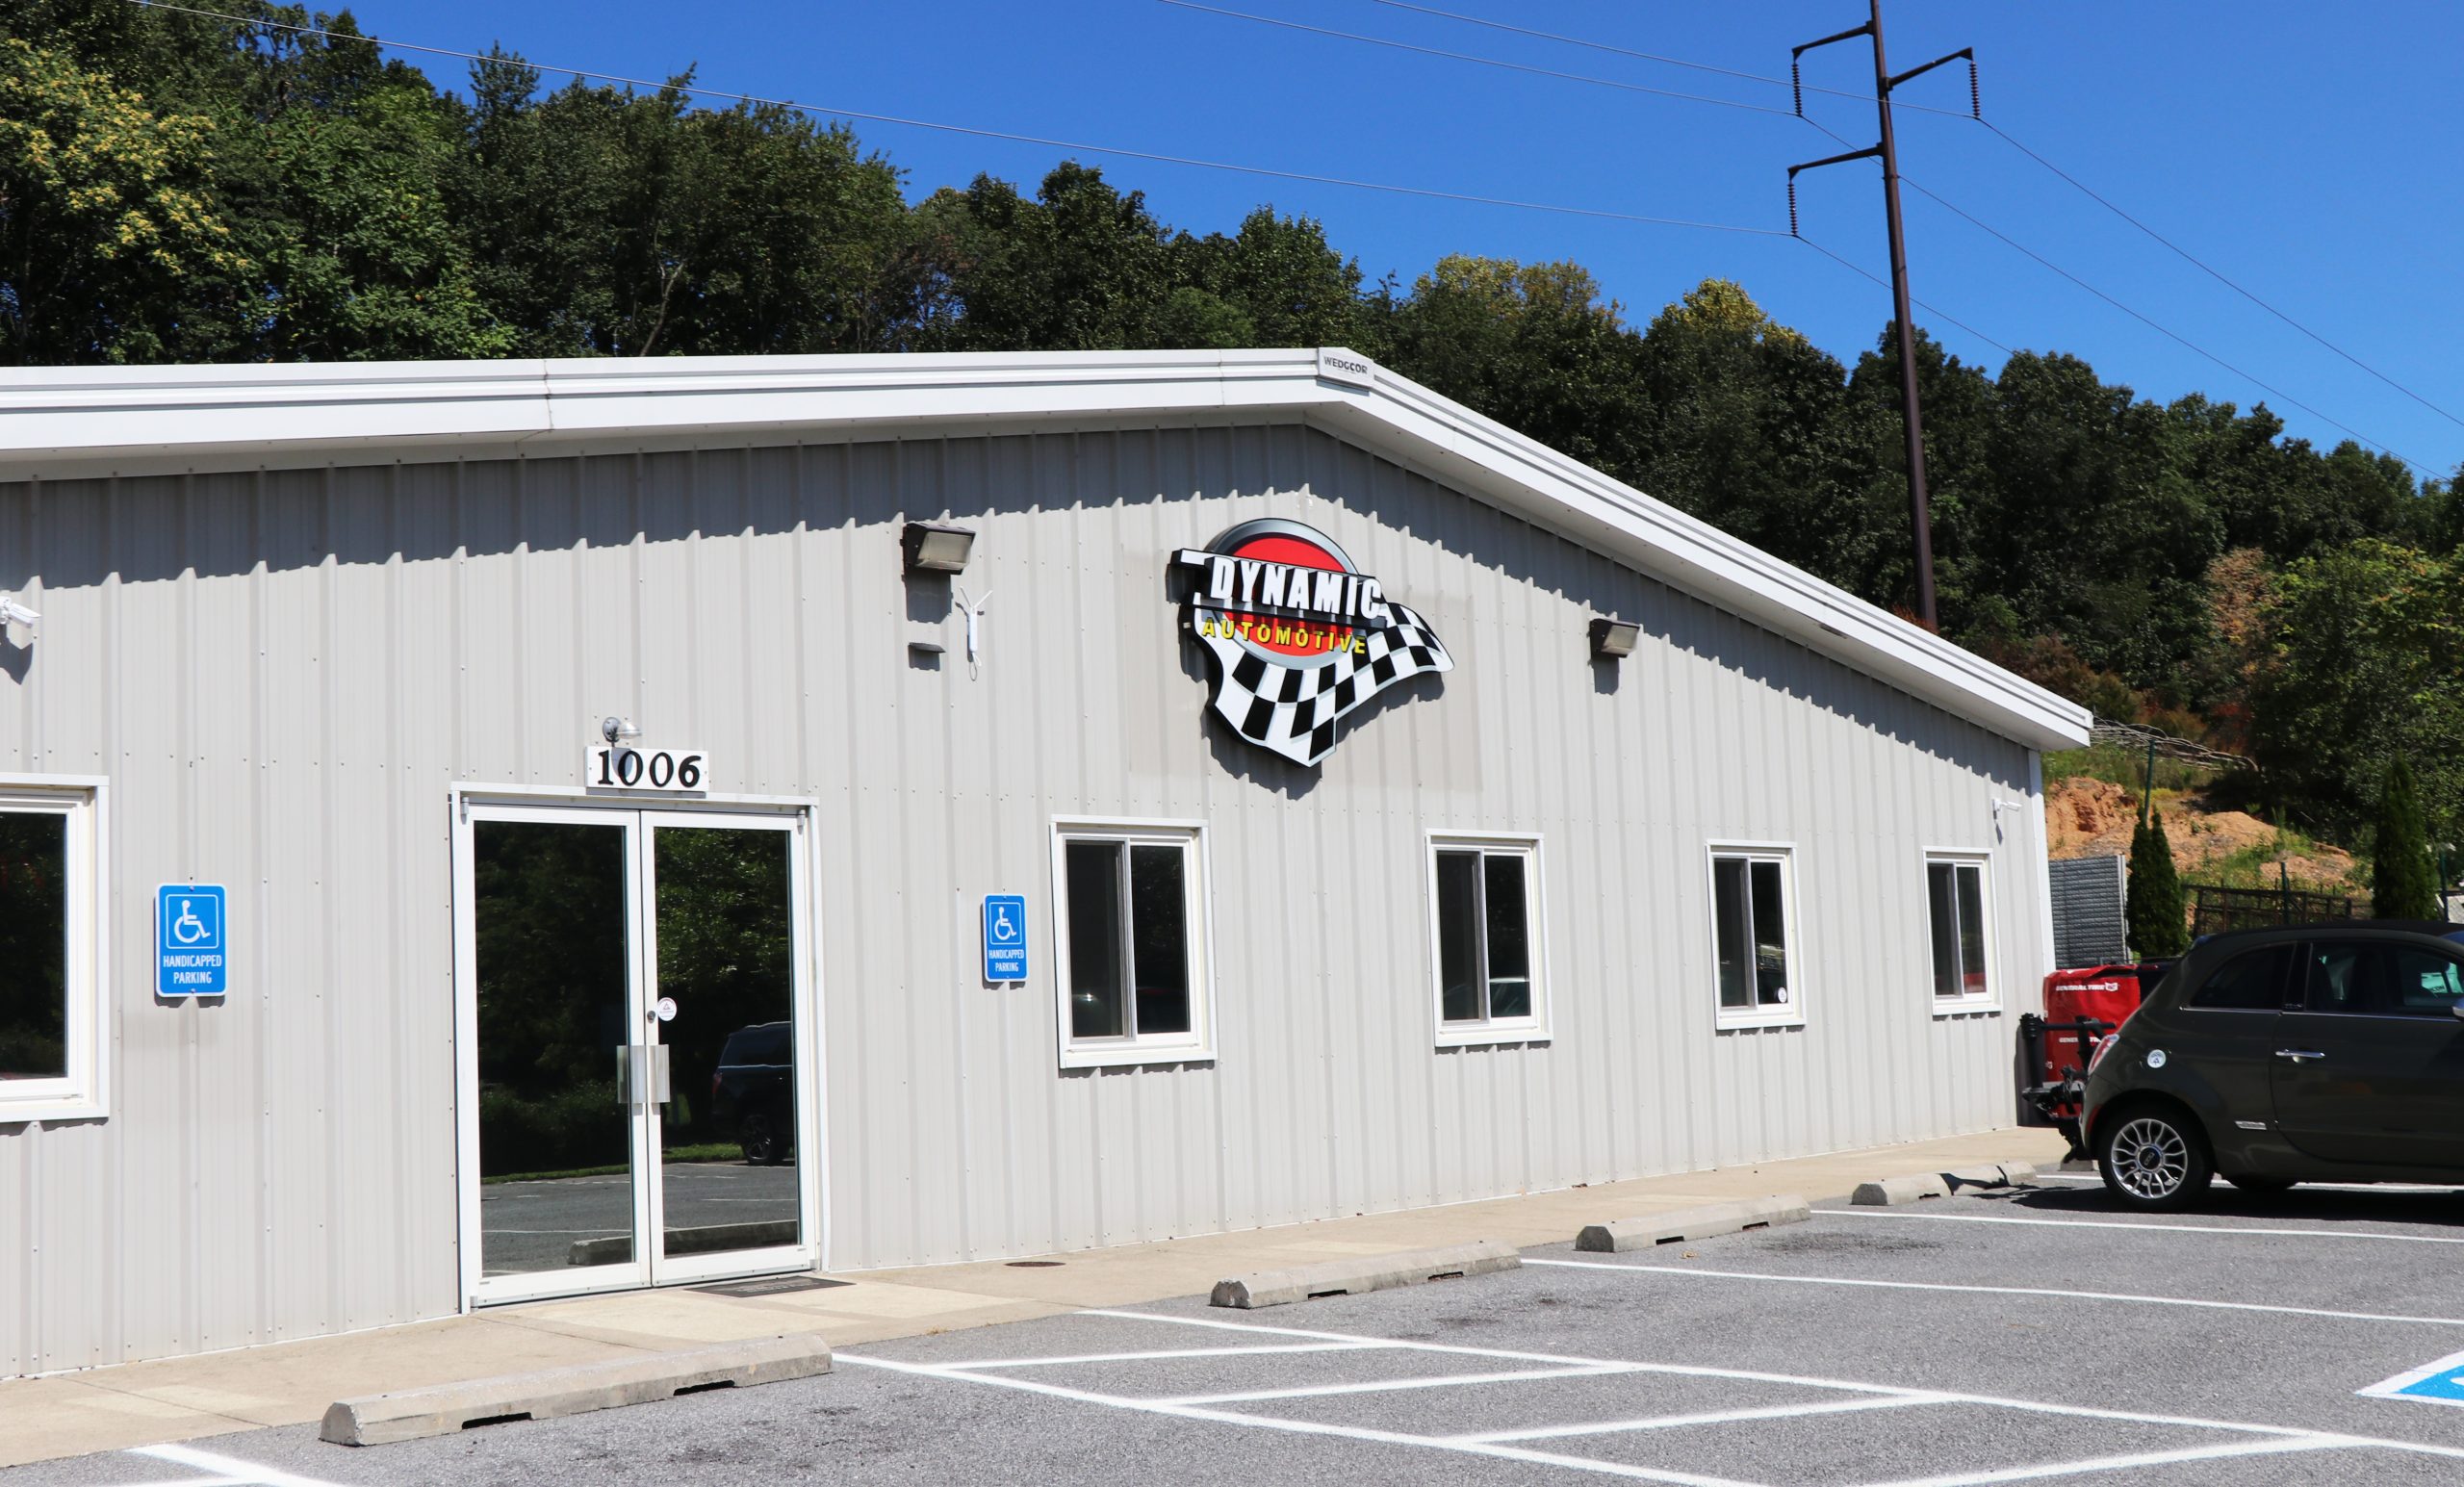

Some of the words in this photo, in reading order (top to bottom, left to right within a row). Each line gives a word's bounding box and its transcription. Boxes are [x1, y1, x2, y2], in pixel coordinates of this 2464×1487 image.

[1323, 356, 1368, 374] WEDGCOR
[1210, 556, 1382, 619] DYNAMIC
[1202, 618, 1367, 654] AUTOMOTIVE
[598, 749, 702, 788] 1006
[163, 955, 222, 967] HANDICAPPED
[988, 949, 1024, 960] HANDICAPPED
[995, 962, 1019, 972] PARKING
[173, 971, 212, 984] PARKING
